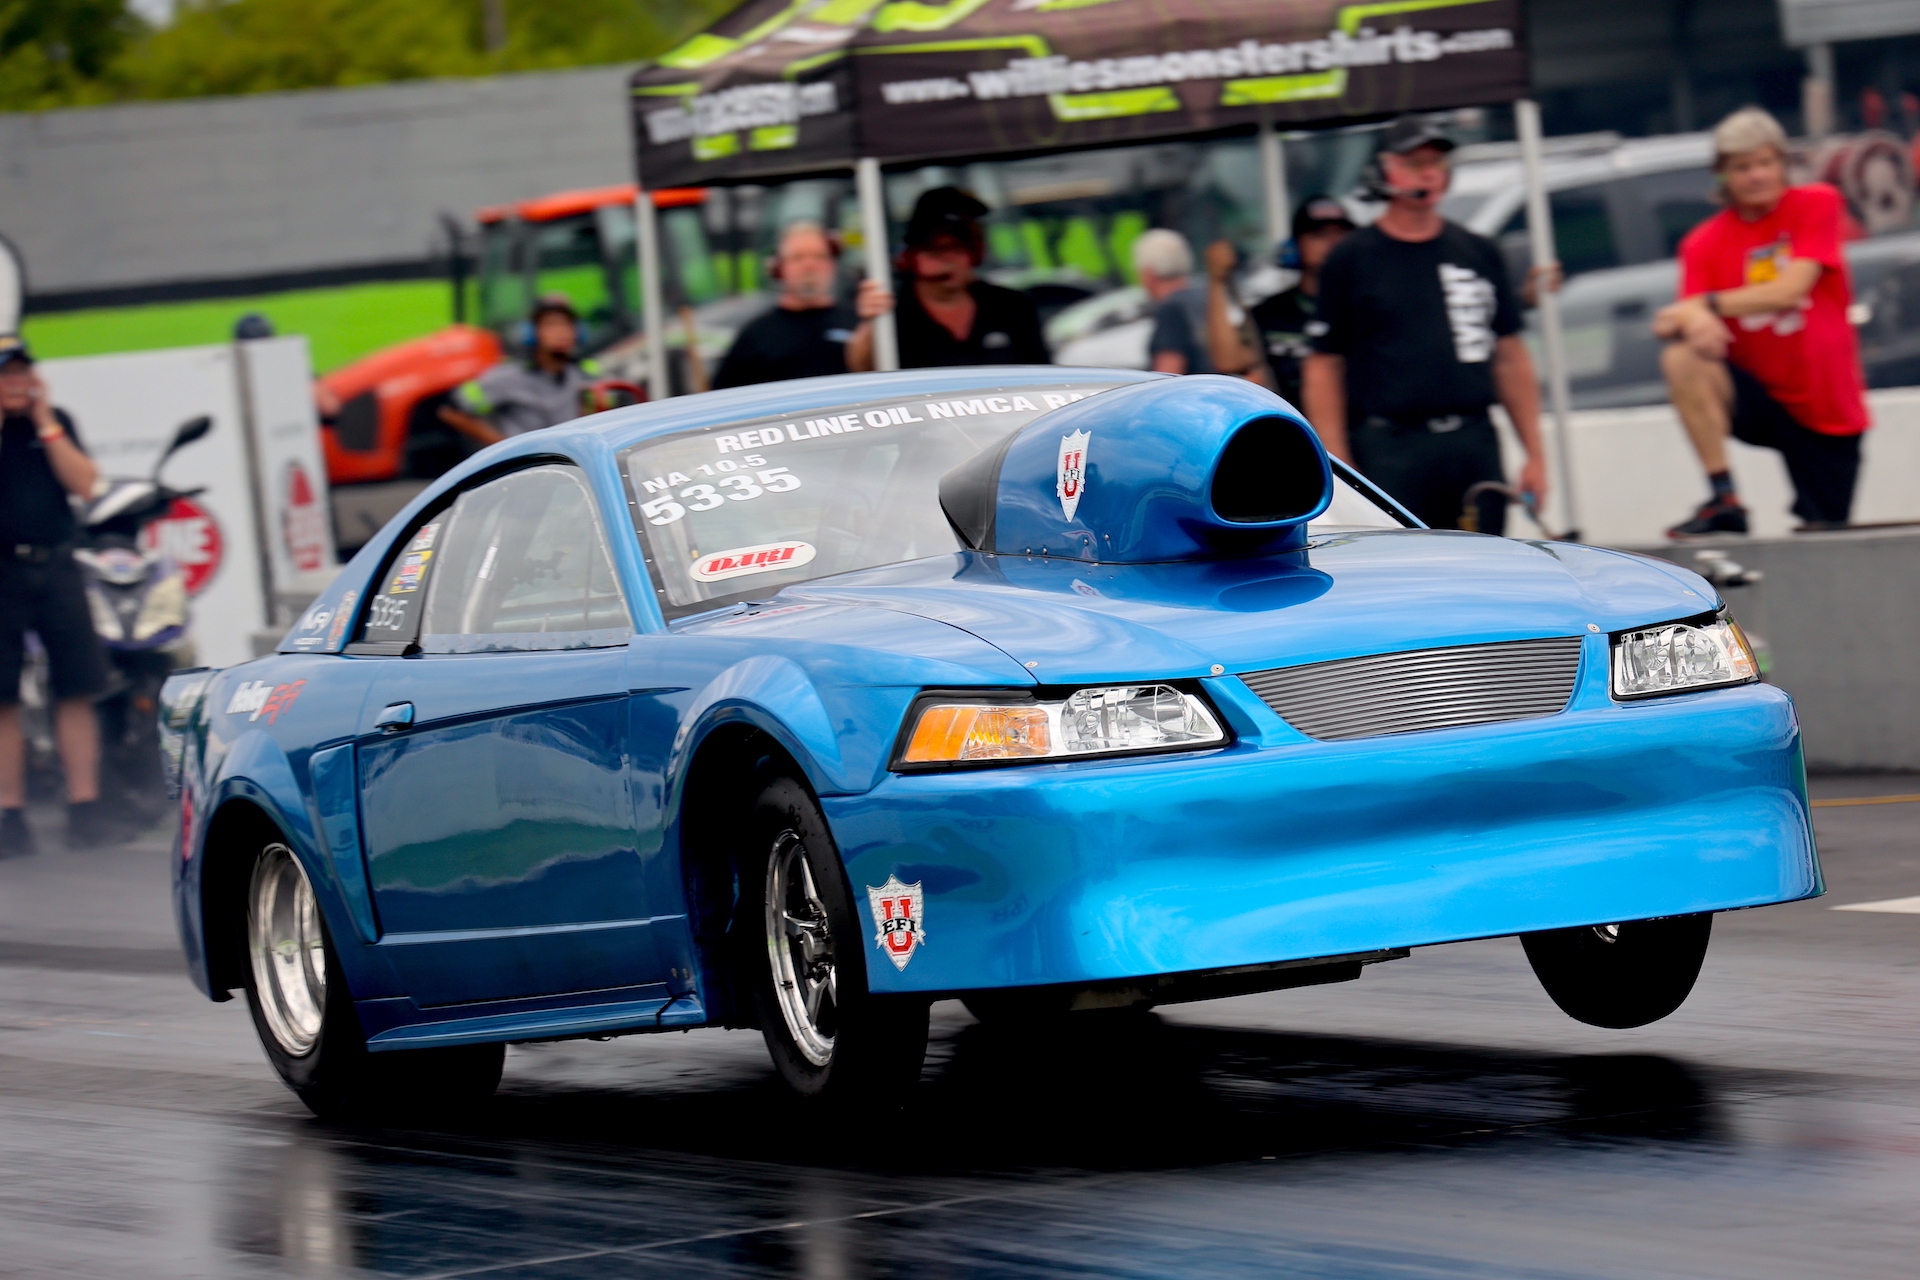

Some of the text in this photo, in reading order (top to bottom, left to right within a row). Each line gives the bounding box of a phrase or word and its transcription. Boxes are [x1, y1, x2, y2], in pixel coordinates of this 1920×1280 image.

[714, 427, 785, 454] RED
[785, 414, 864, 441] LINE
[864, 406, 924, 428] OIL
[925, 396, 1039, 420] NMCA
[640, 467, 802, 526] 5335
[641, 454, 768, 494] NA 10.5
[882, 918, 916, 936] EFI
